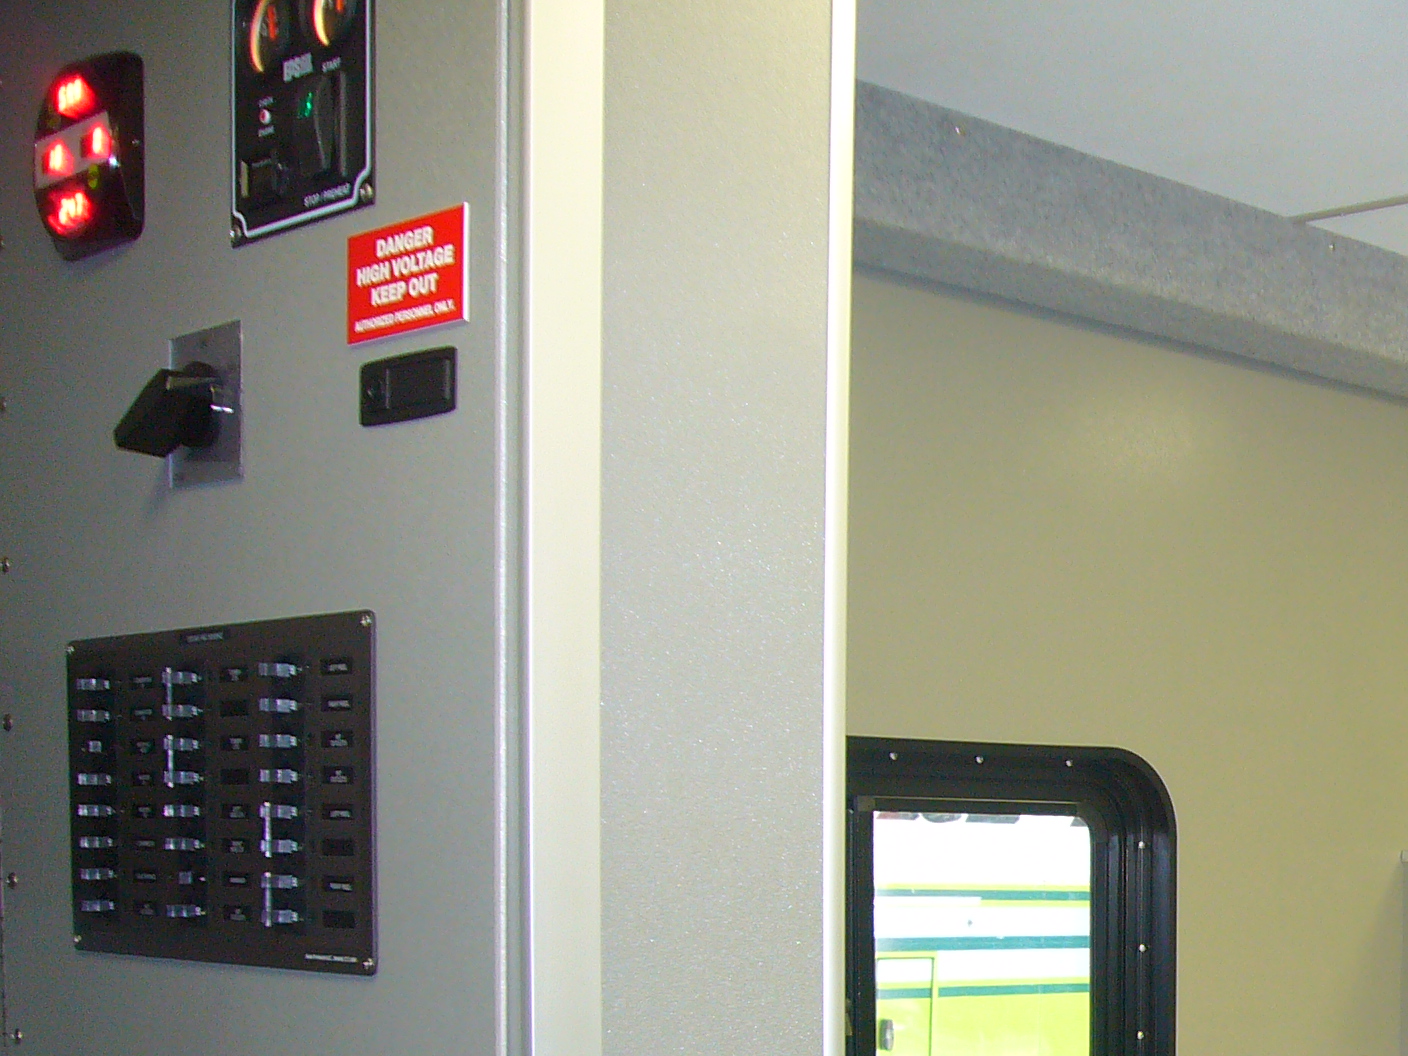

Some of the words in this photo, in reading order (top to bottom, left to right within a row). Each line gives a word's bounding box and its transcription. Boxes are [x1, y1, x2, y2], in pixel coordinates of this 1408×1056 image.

[376, 225, 434, 259] DANGER
[356, 260, 391, 288] HIGH
[391, 243, 455, 278] VOLTAGE
[371, 280, 406, 307] KEEP
[408, 272, 439, 298] OUT
